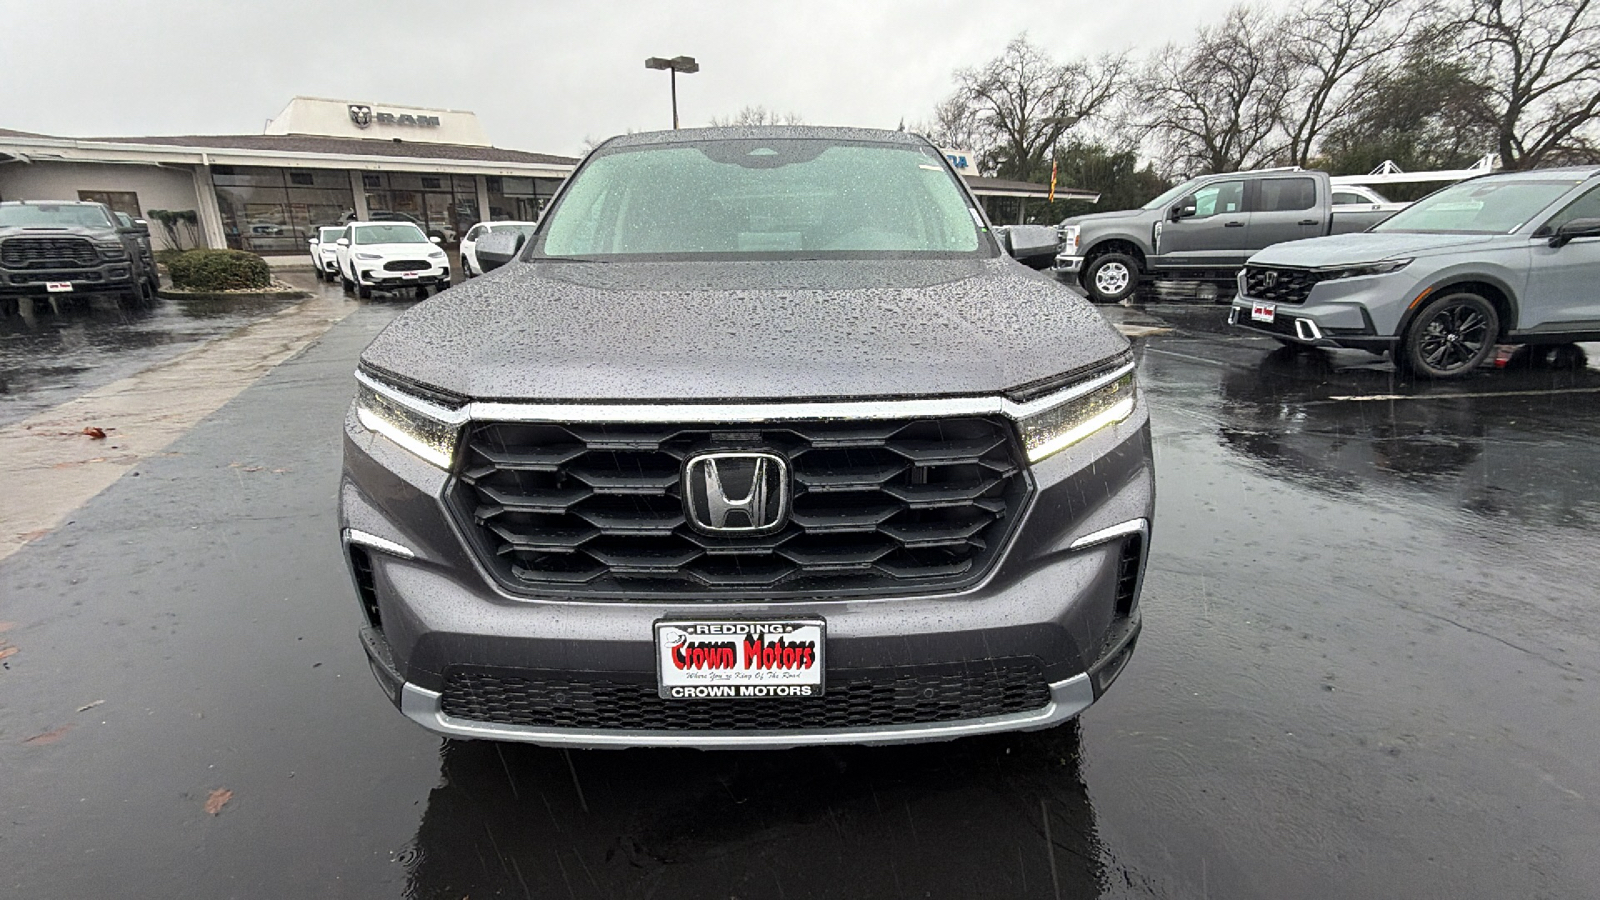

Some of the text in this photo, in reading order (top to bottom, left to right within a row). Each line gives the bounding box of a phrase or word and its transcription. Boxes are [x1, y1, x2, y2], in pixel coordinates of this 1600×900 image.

[376, 112, 440, 127] RAM
[696, 624, 783, 634] REDDING
[671, 636, 815, 671] Crown Motors
[686, 671, 708, 679] Where
[734, 671, 753, 680] King
[767, 671, 780, 679] The
[671, 685, 812, 698] CROWN MOTORS
